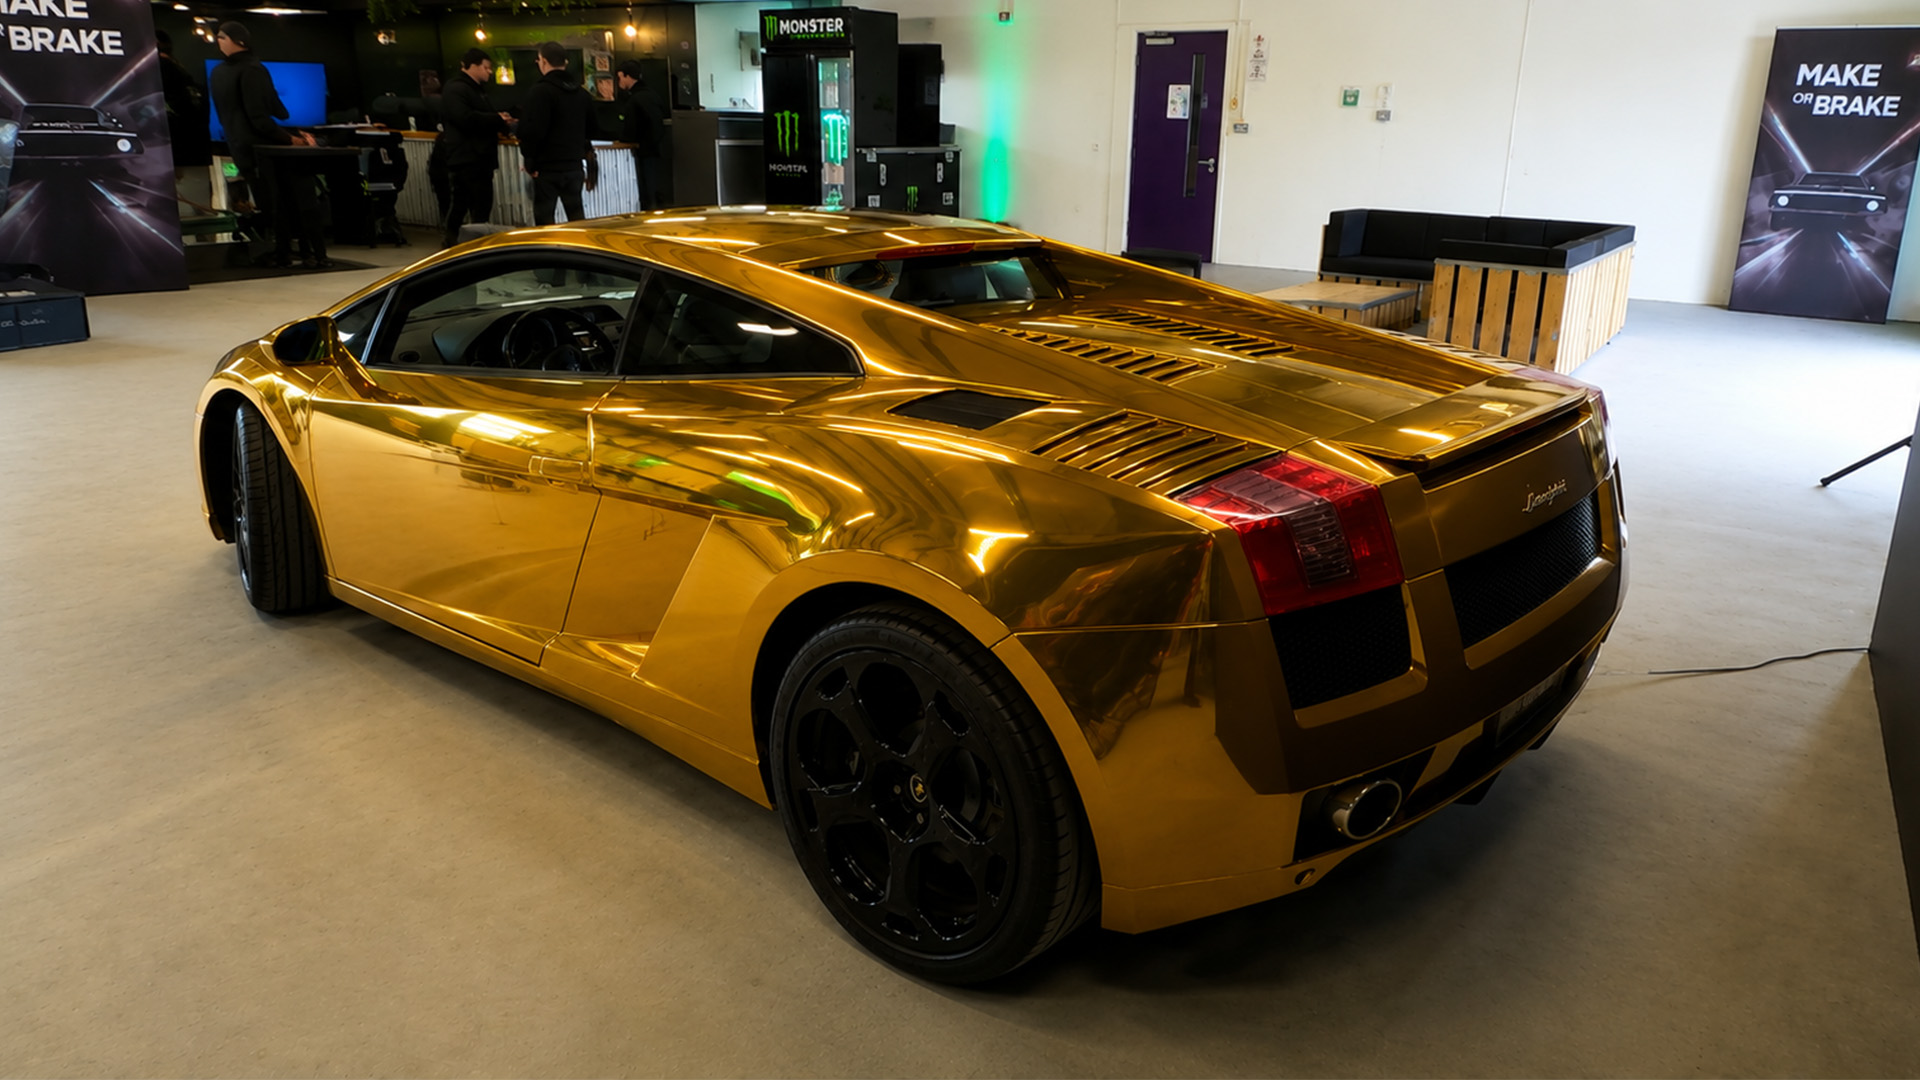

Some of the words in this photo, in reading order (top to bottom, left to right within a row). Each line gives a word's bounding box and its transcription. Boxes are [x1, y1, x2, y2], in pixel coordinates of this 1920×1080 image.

[0, 0, 89, 19] AKE
[780, 17, 844, 35] MONSTER
[8, 25, 125, 56] BRAKE
[1795, 63, 1883, 87] MAKE
[1792, 92, 1814, 104] OR
[1812, 95, 1901, 117] BRAKE
